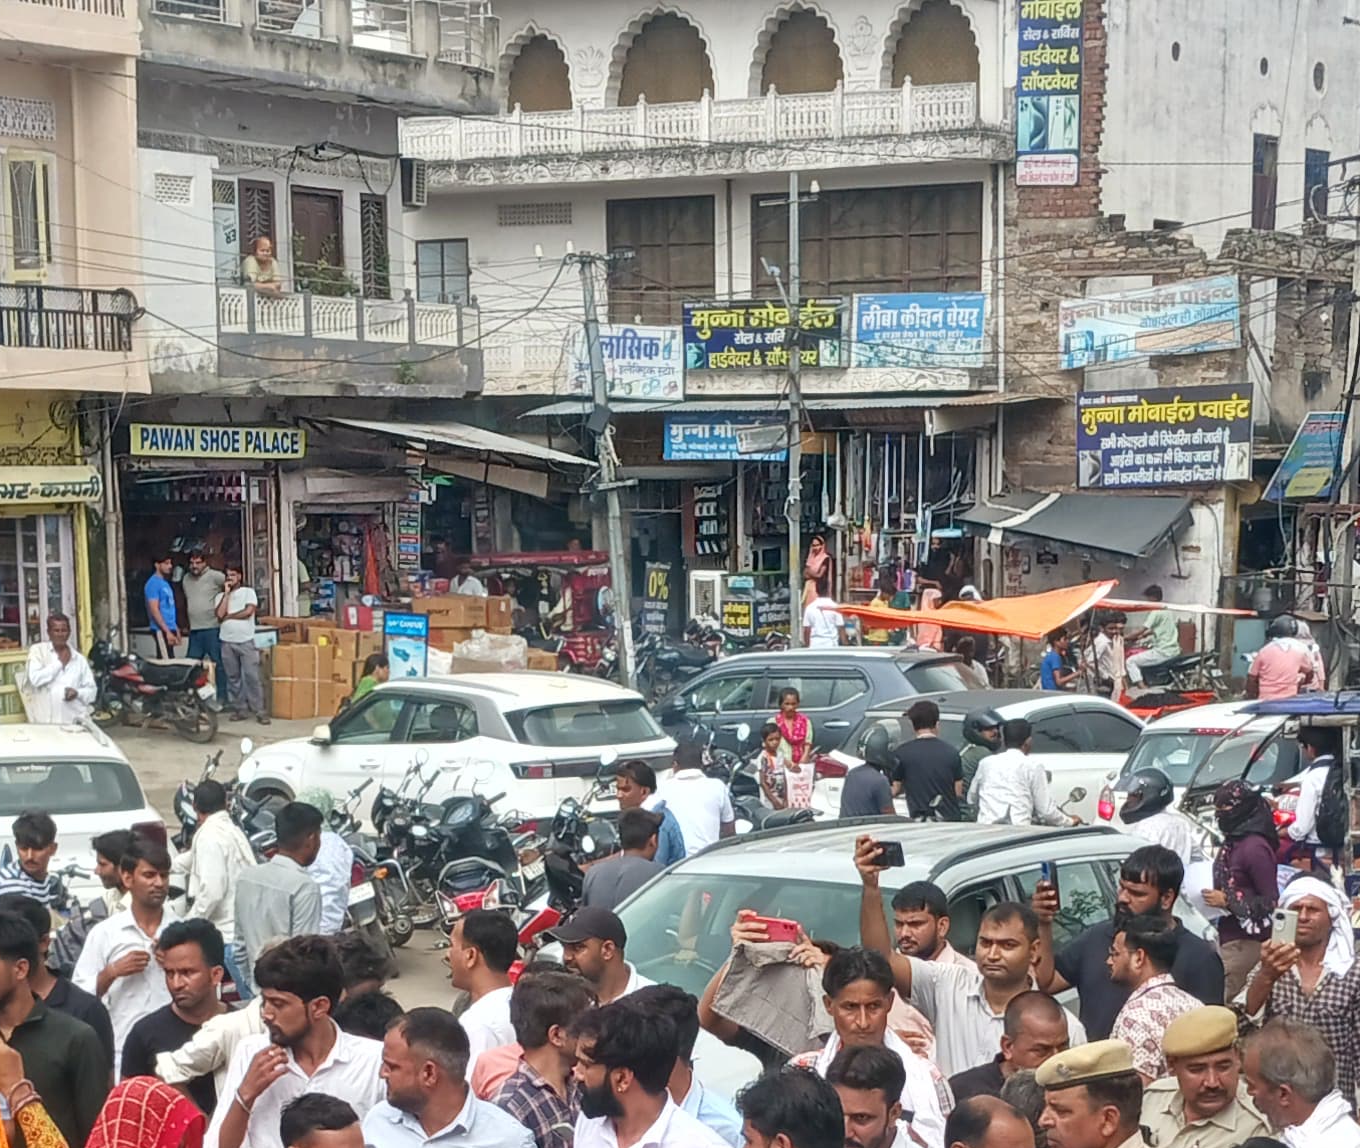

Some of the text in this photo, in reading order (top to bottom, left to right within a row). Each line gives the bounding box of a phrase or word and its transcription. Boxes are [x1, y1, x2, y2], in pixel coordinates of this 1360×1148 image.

[1070, 46, 1079, 63] &
[690, 298, 836, 339] मुन्ना मोबईल
[598, 327, 662, 360] लासिक
[764, 327, 786, 344] सर्वि
[753, 349, 763, 366] &
[1081, 392, 1250, 435] मुन्ना मोबाईल प्वाइंट
[140, 427, 300, 454] PAWAN SHOE PALACE
[669, 423, 710, 443] मुन्ना
[648, 571, 669, 600] 0%
